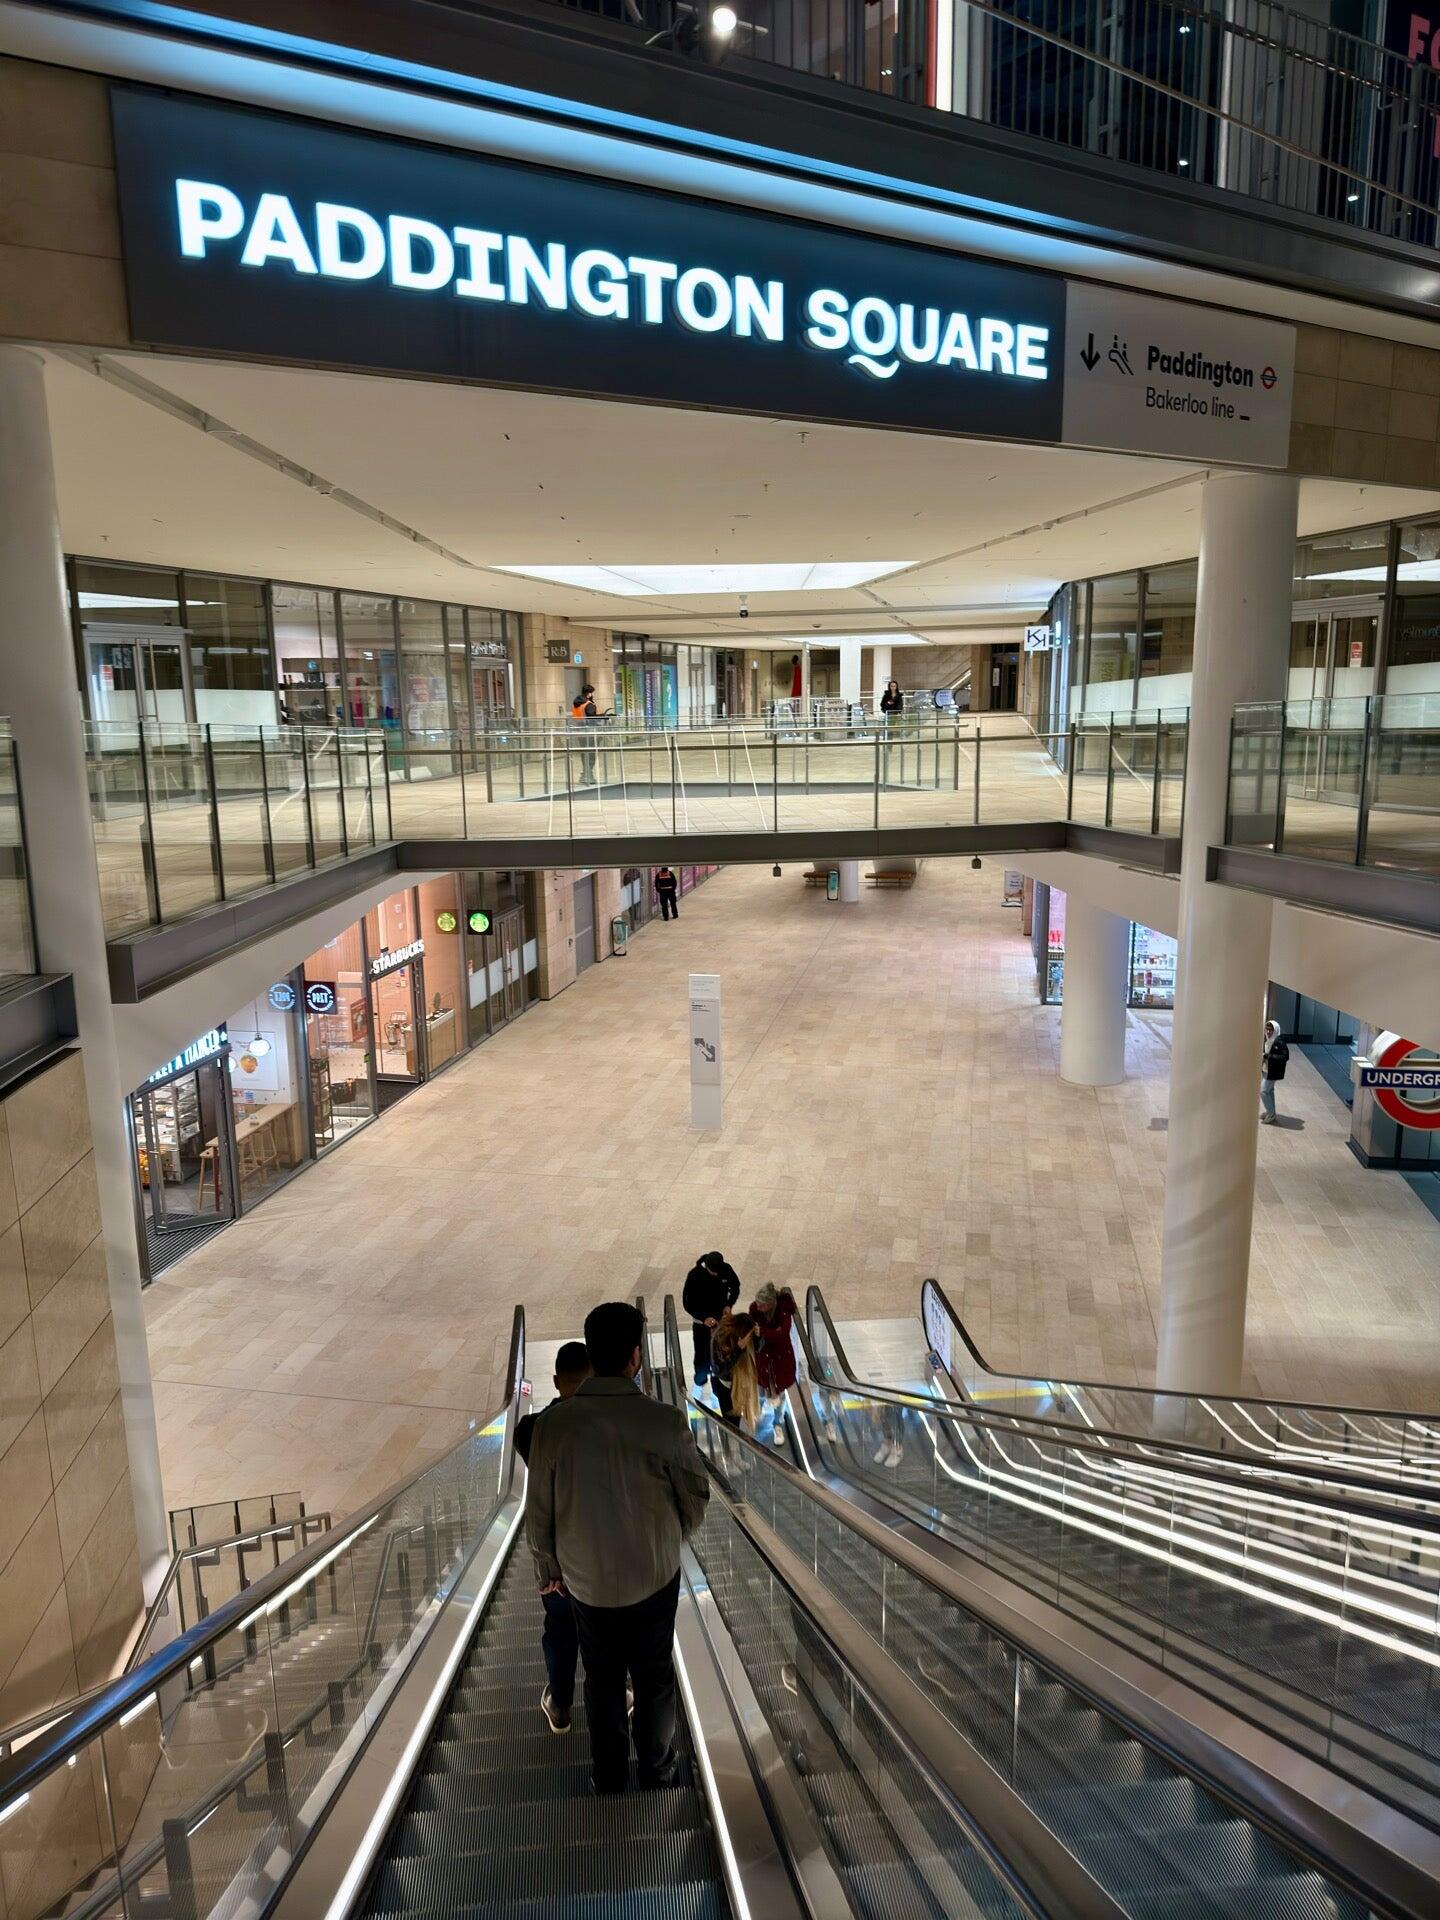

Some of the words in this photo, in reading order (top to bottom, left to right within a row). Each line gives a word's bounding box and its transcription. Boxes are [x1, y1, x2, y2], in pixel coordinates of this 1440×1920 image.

[176, 178, 784, 342] PADDINGTON
[807, 287, 1050, 380] SQUARE
[1147, 345, 1254, 388] Paddington
[1145, 387, 1207, 415] Bakerloo
[1211, 396, 1235, 419] line
[372, 938, 425, 974] STARBUCKS
